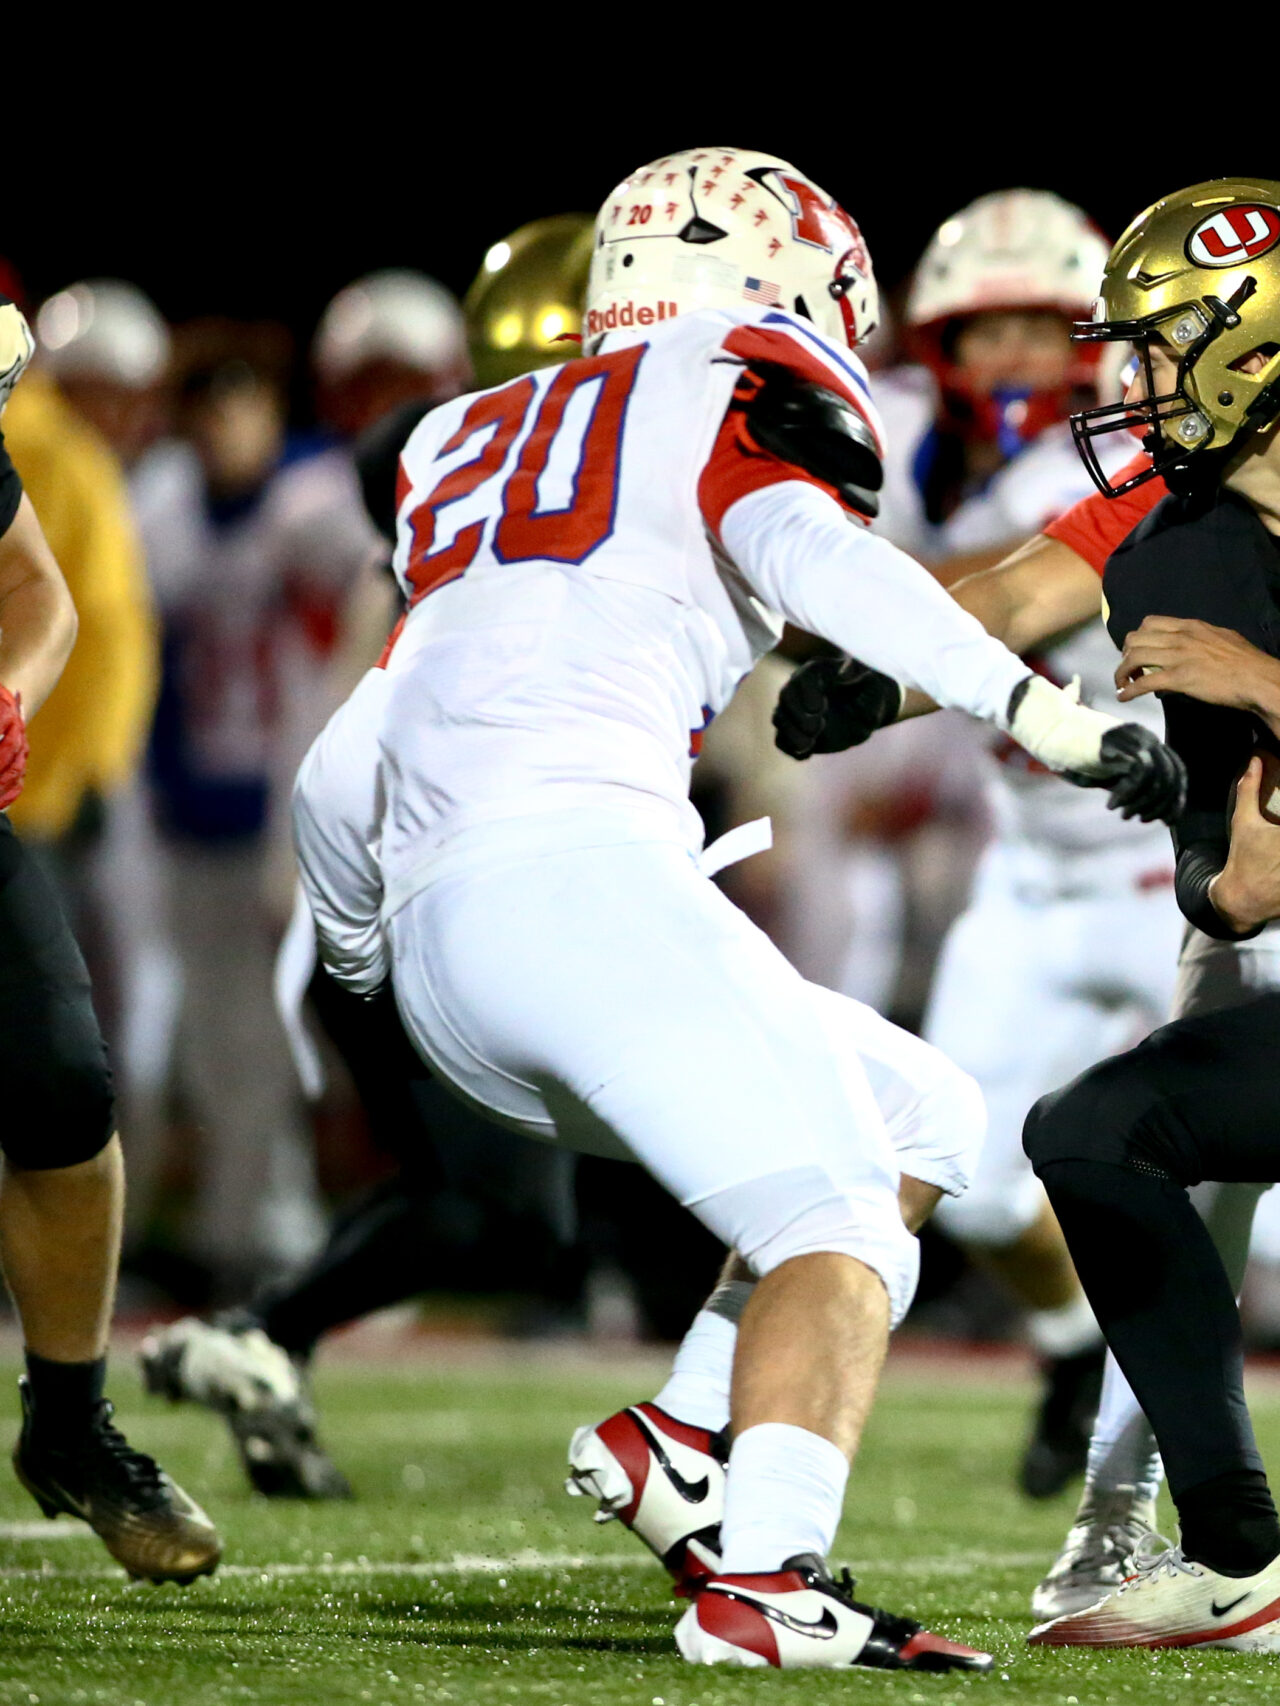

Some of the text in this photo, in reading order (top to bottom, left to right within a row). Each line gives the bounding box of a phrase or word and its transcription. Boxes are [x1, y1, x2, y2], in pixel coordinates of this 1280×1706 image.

[626, 204, 653, 226] 20
[587, 300, 678, 337] Riddell
[405, 341, 651, 609] 20
